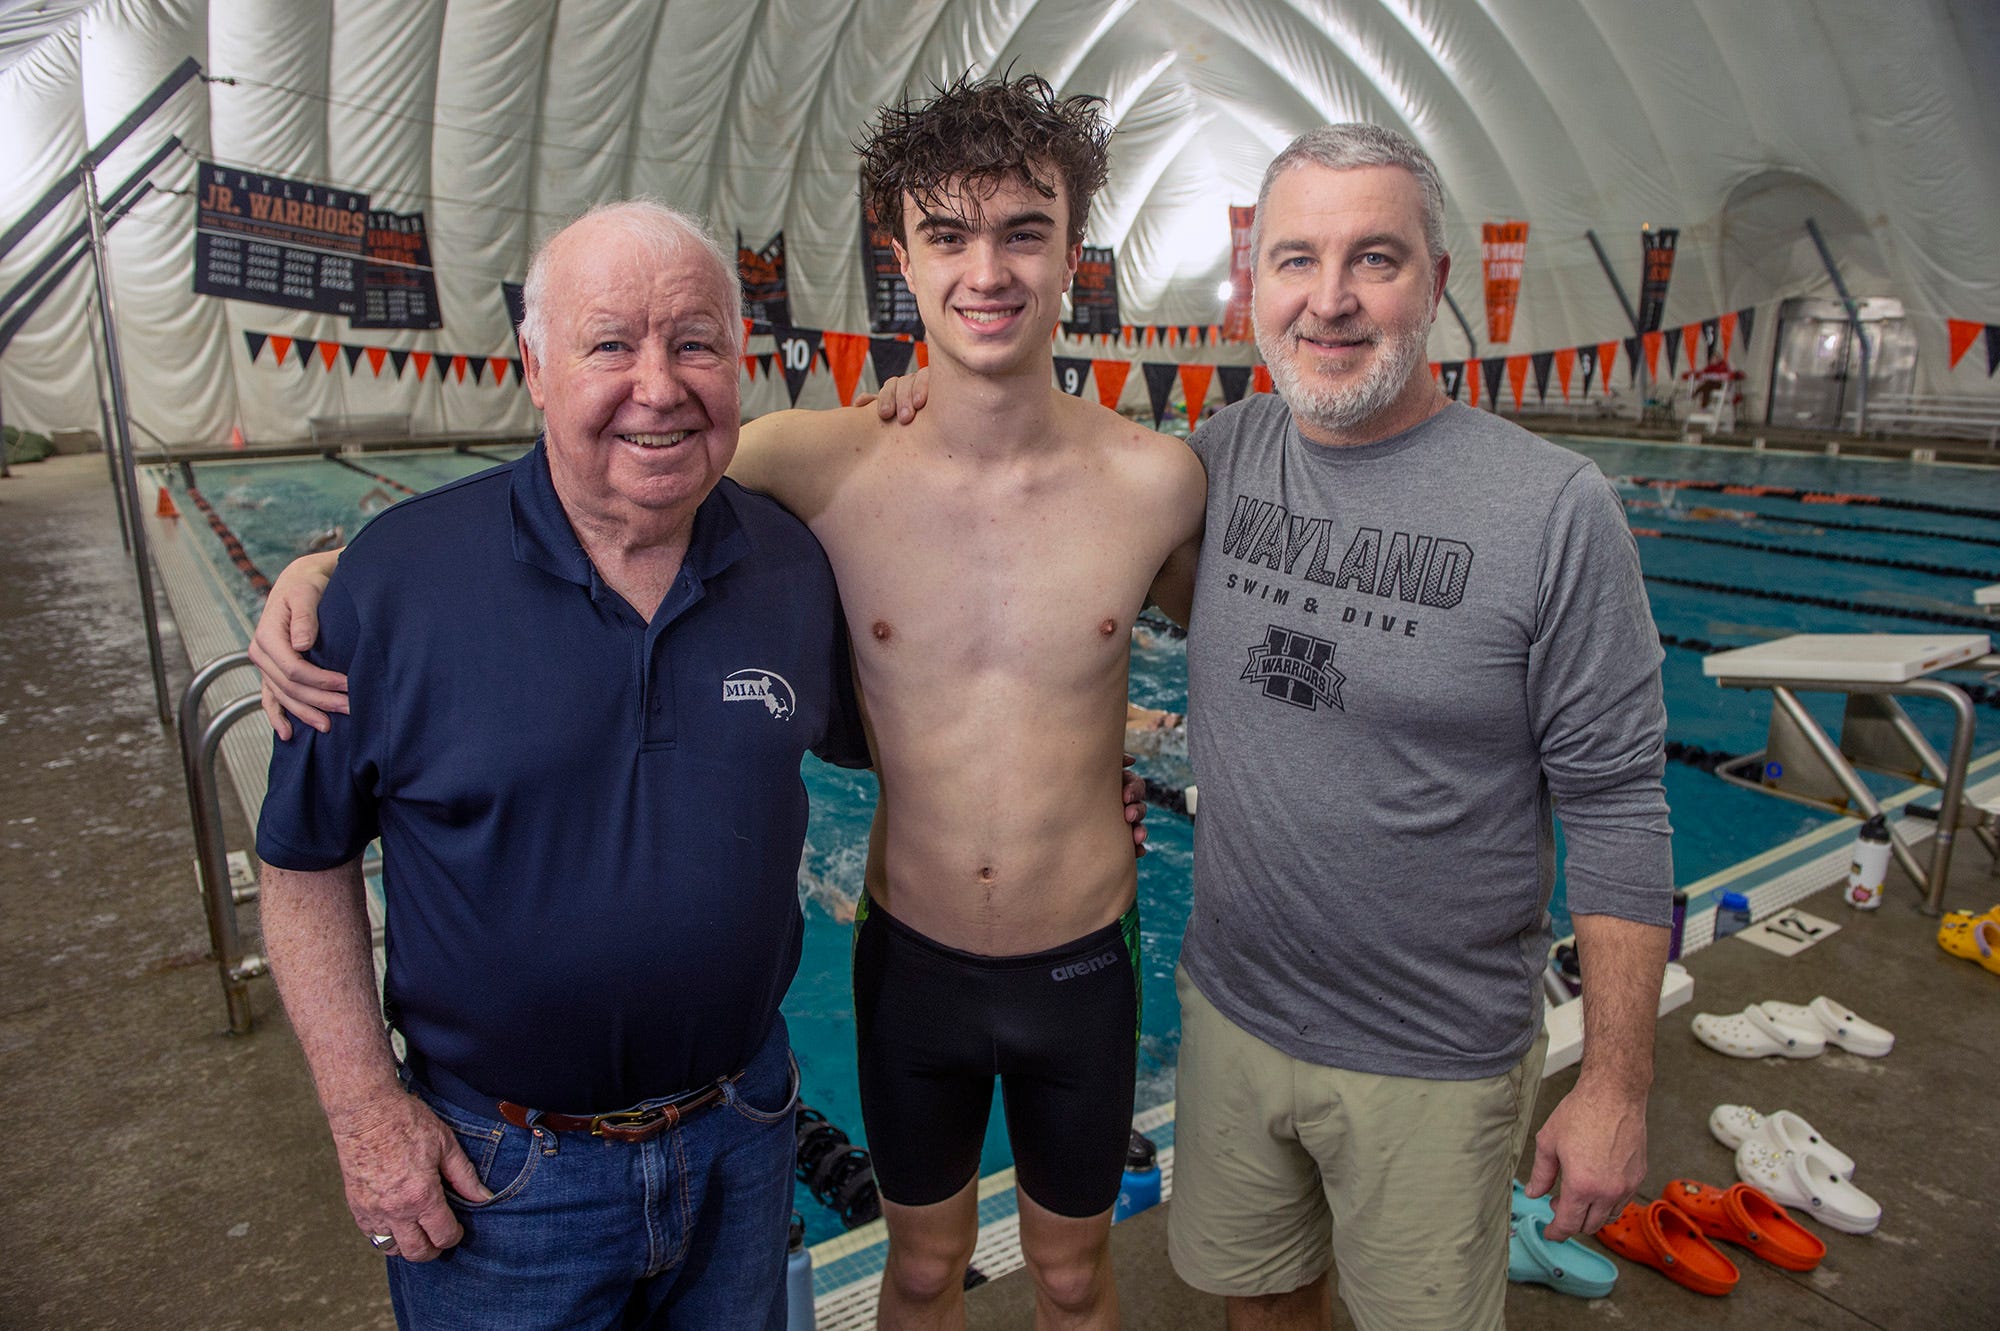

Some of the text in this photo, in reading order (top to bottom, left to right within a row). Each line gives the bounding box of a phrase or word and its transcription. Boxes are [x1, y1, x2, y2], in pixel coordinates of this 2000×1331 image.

[213, 170, 358, 212] WAYLAND
[201, 183, 366, 238] JR. WARRIORS
[246, 266, 279, 280] 2007
[283, 272, 312, 287] 2011
[284, 261, 315, 275] 2010
[781, 338, 810, 371] 10
[1065, 367, 1079, 394] 9
[1446, 370, 1457, 393] 7
[1222, 494, 1474, 610] WAYLAND
[1226, 573, 1419, 638] SWIM & DIVE
[726, 683, 767, 697] MIAA
[1261, 657, 1327, 694] WARRIORS
[1765, 918, 1823, 943] 12
[1051, 950, 1118, 982] arena
